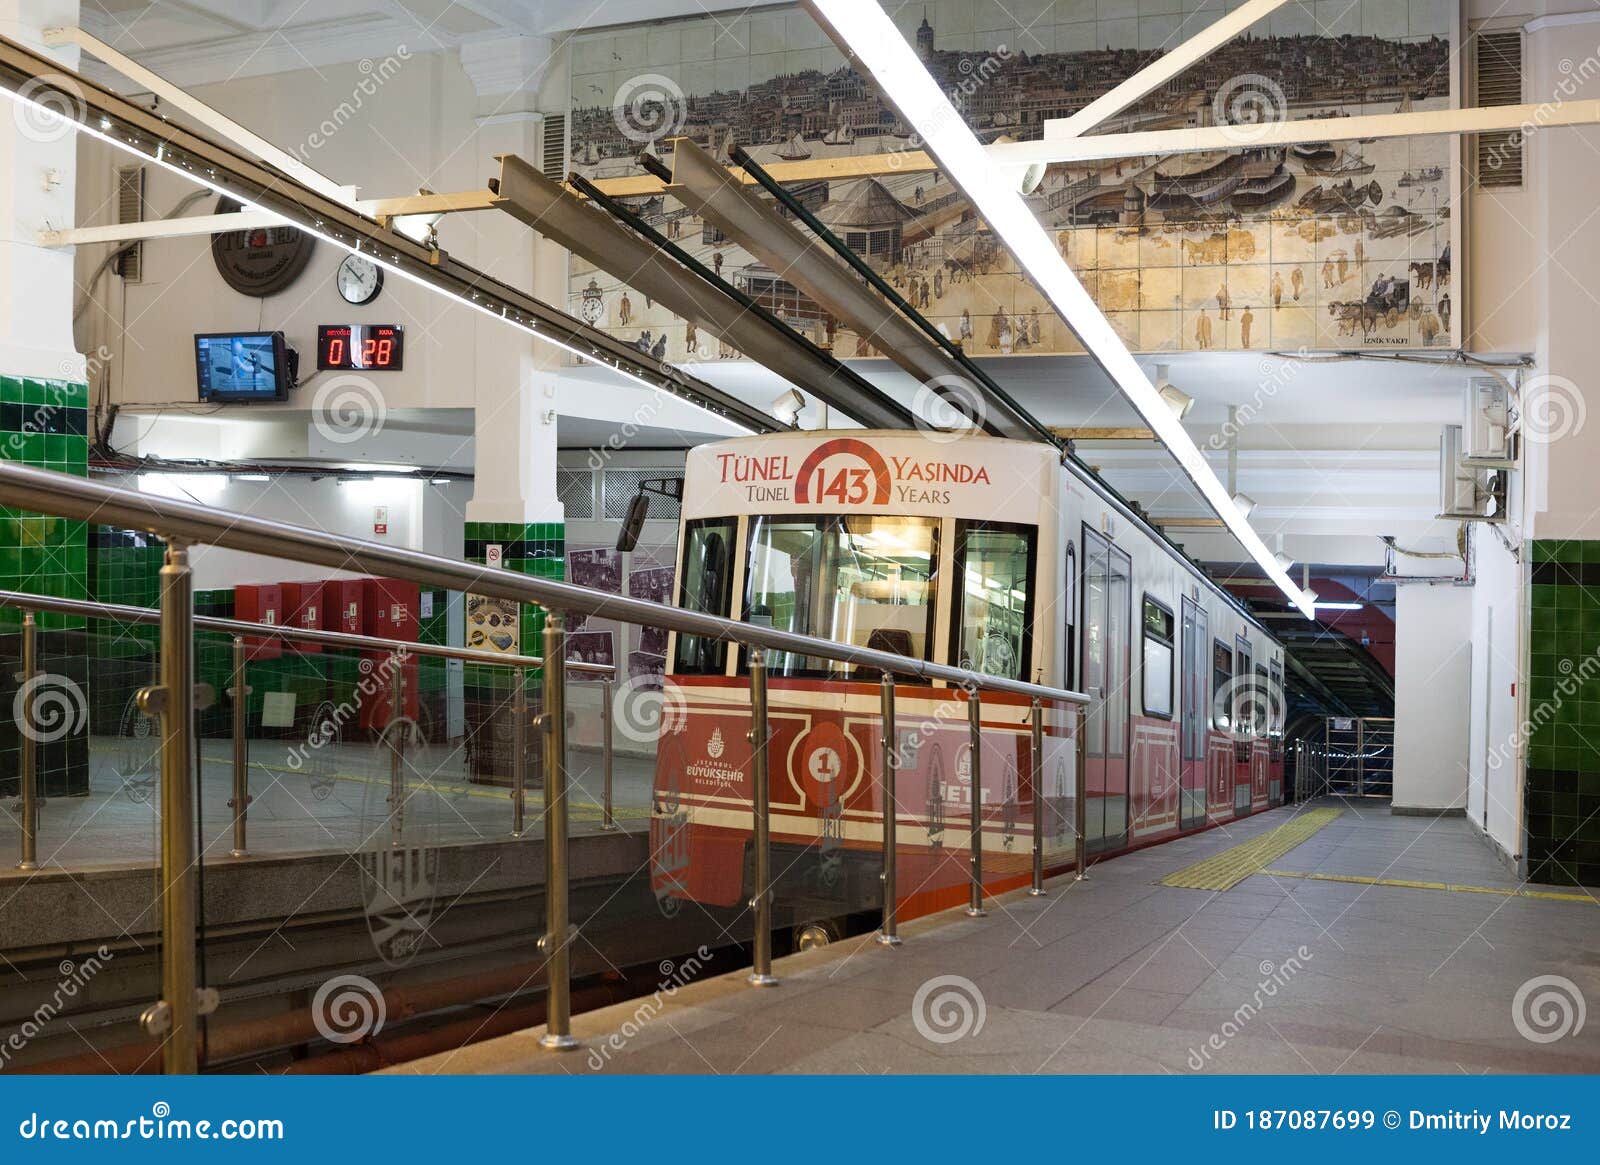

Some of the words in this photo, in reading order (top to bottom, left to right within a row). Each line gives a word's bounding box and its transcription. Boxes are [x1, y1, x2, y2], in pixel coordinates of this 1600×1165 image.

[717, 453, 793, 483] TÜNEL
[816, 468, 871, 504] 143
[889, 456, 992, 486] YAŞINDA
[896, 485, 951, 505] YEARS
[817, 752, 831, 774] 1
